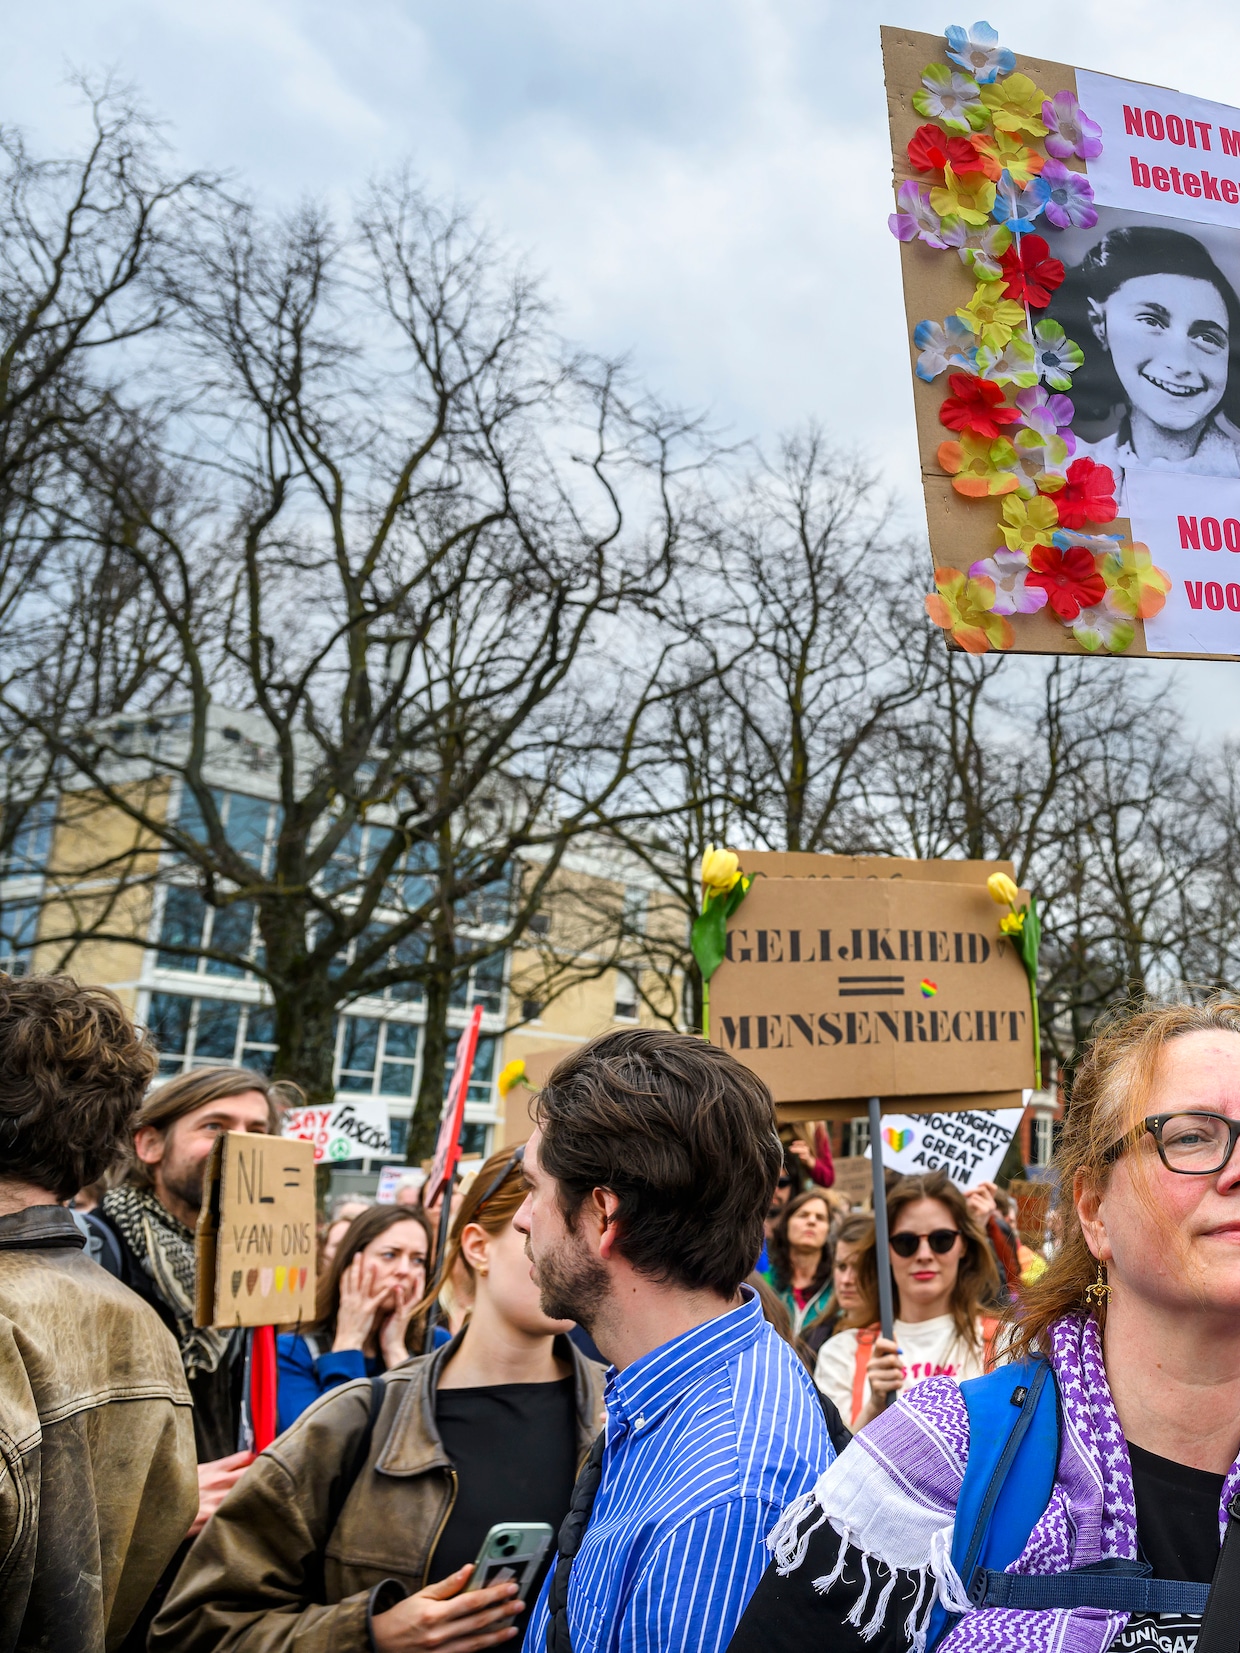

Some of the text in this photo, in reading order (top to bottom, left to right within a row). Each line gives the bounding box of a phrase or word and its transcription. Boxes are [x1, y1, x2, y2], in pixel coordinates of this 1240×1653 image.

[1122, 104, 1213, 152] NOOIT
[724, 928, 991, 964] GELIJKHEID
[719, 1009, 1027, 1050] MENSENRECHT
[289, 1109, 332, 1131] SAY
[906, 1113, 1000, 1157] MOCRACY
[955, 1111, 1013, 1144] RIGHTS
[911, 1150, 973, 1186] AGAIN
[921, 1133, 984, 1170] GREAT
[237, 1147, 275, 1205] NL
[232, 1222, 312, 1257] VAN ONS
